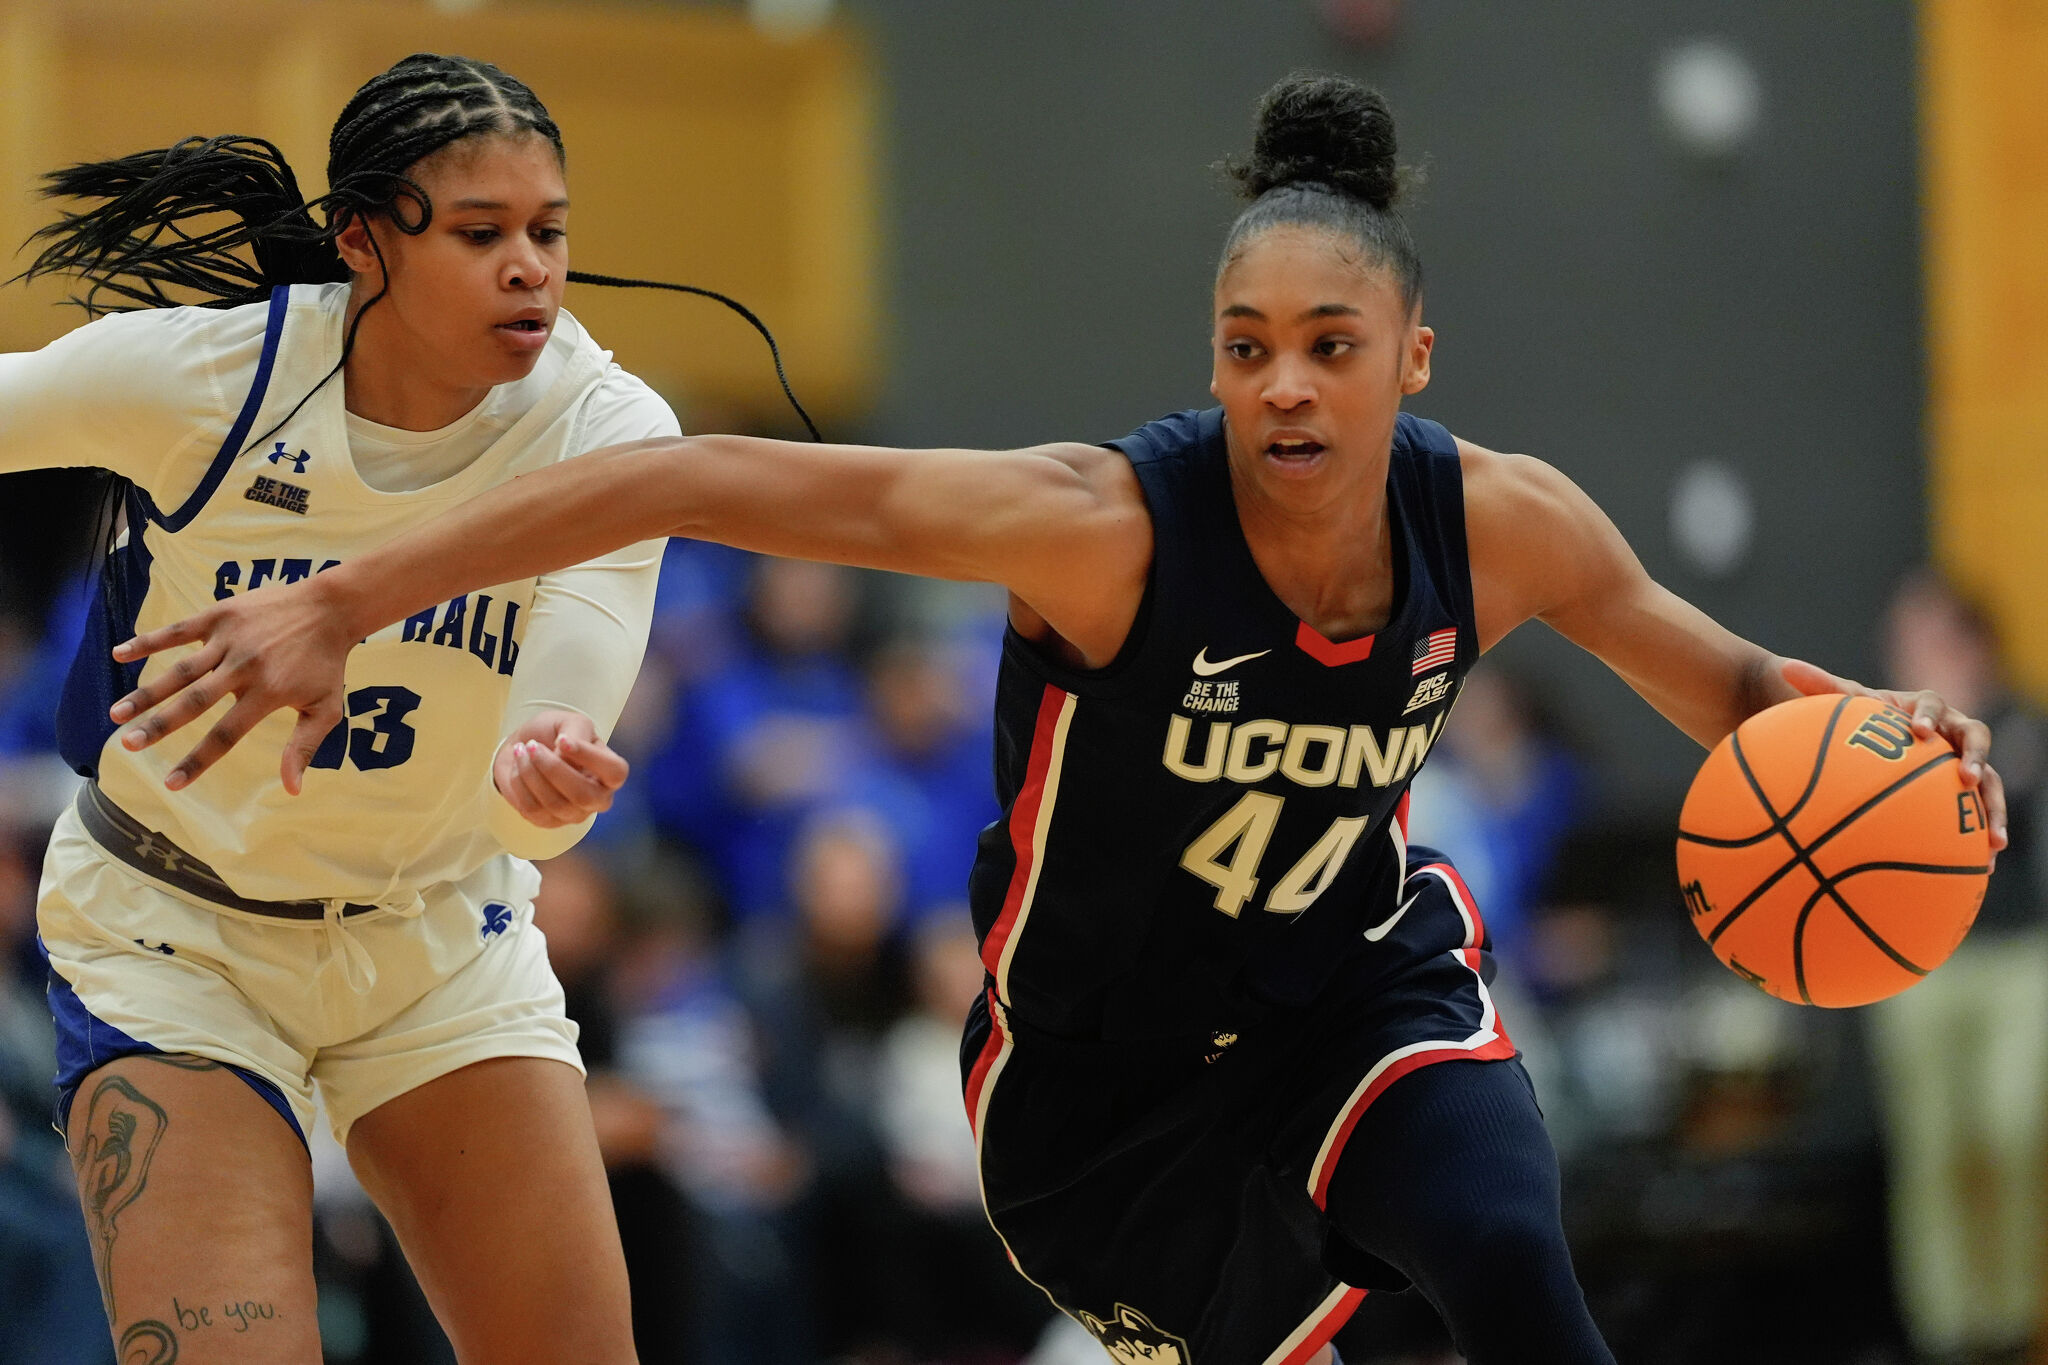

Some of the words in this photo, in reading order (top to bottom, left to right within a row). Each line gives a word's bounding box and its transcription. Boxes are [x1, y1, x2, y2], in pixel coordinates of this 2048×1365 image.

[244, 487, 309, 515] CHANGE
[253, 475, 277, 493] BE
[279, 482, 311, 503] THE
[1190, 680, 1212, 697] BE
[1216, 681, 1240, 697] THE
[1406, 680, 1453, 708] EAST
[1414, 671, 1447, 696] BIG
[1182, 693, 1240, 712] CHANGE
[1162, 709, 1444, 788] UCONN
[1178, 790, 1369, 920] 44
[173, 1297, 213, 1331] be
